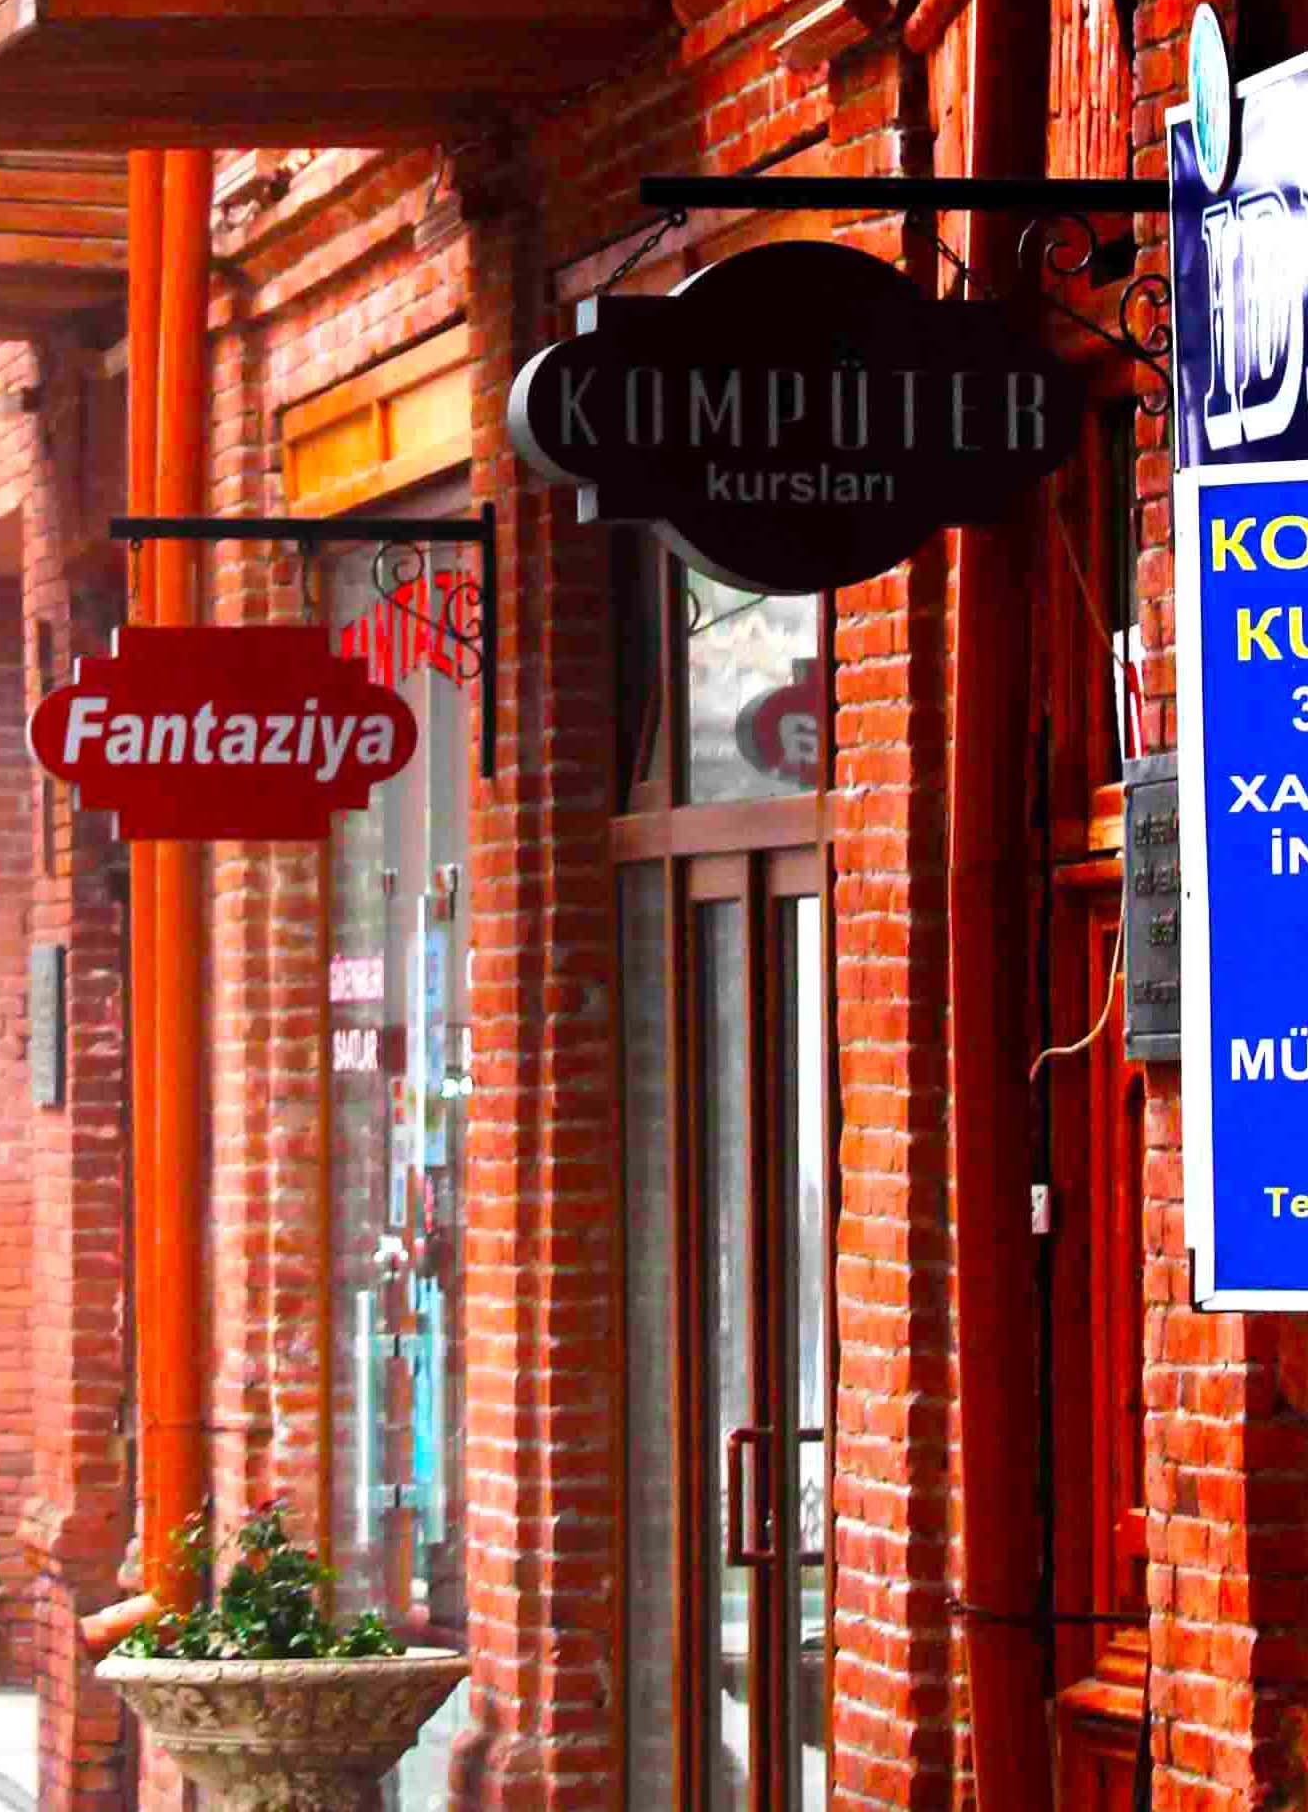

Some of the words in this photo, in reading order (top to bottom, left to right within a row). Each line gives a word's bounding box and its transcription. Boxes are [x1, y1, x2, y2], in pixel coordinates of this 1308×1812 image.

[560, 359, 1046, 451] KOMPÜTER
[706, 462, 895, 502] kursları
[62, 697, 394, 782] Fantaziya
